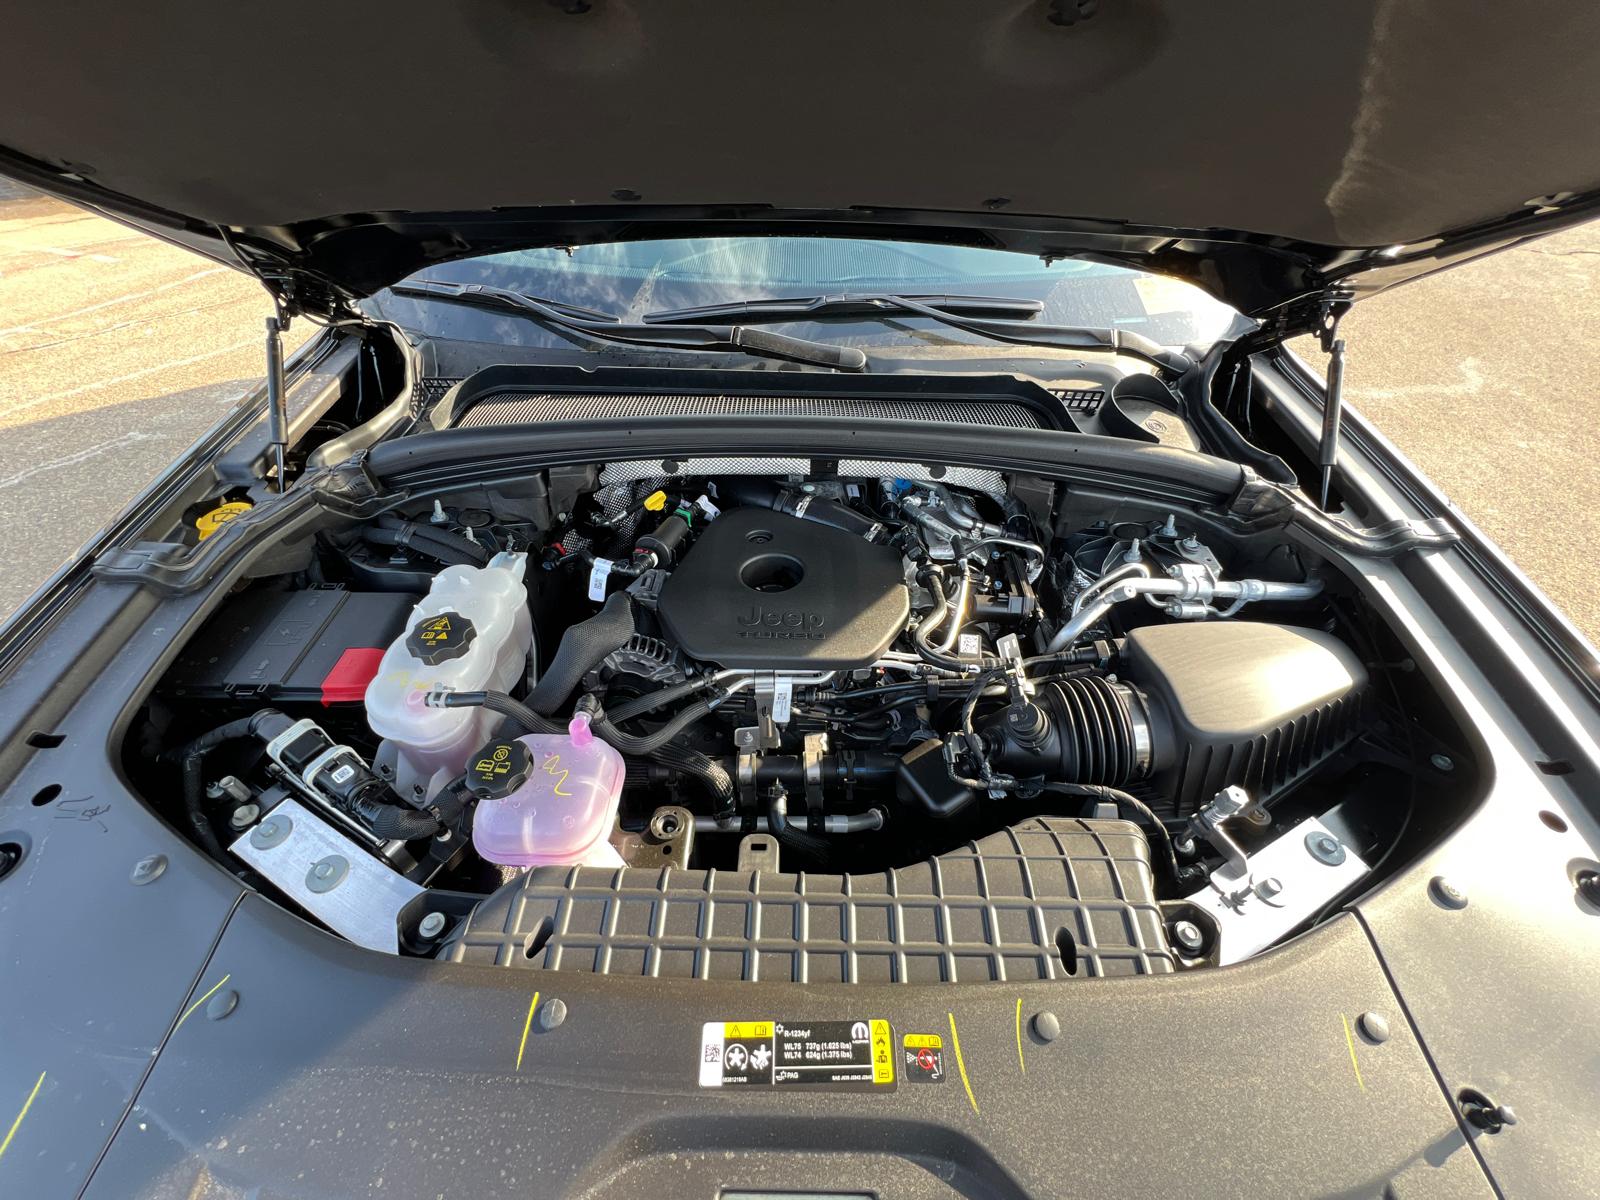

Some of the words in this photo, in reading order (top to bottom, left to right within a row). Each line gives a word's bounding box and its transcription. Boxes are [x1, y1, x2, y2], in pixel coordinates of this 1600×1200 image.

[738, 606, 824, 631] Jeep
[737, 631, 825, 640] TURBO
[784, 1029, 811, 1038] R-1234yf
[805, 1042, 821, 1051] 737g
[821, 1042, 840, 1050] (1.625
[840, 1041, 852, 1050] lbs)
[784, 1051, 802, 1059] WL74
[805, 1051, 821, 1060] 624g
[821, 1051, 840, 1059] (1.375
[840, 1050, 852, 1059] lbs)
